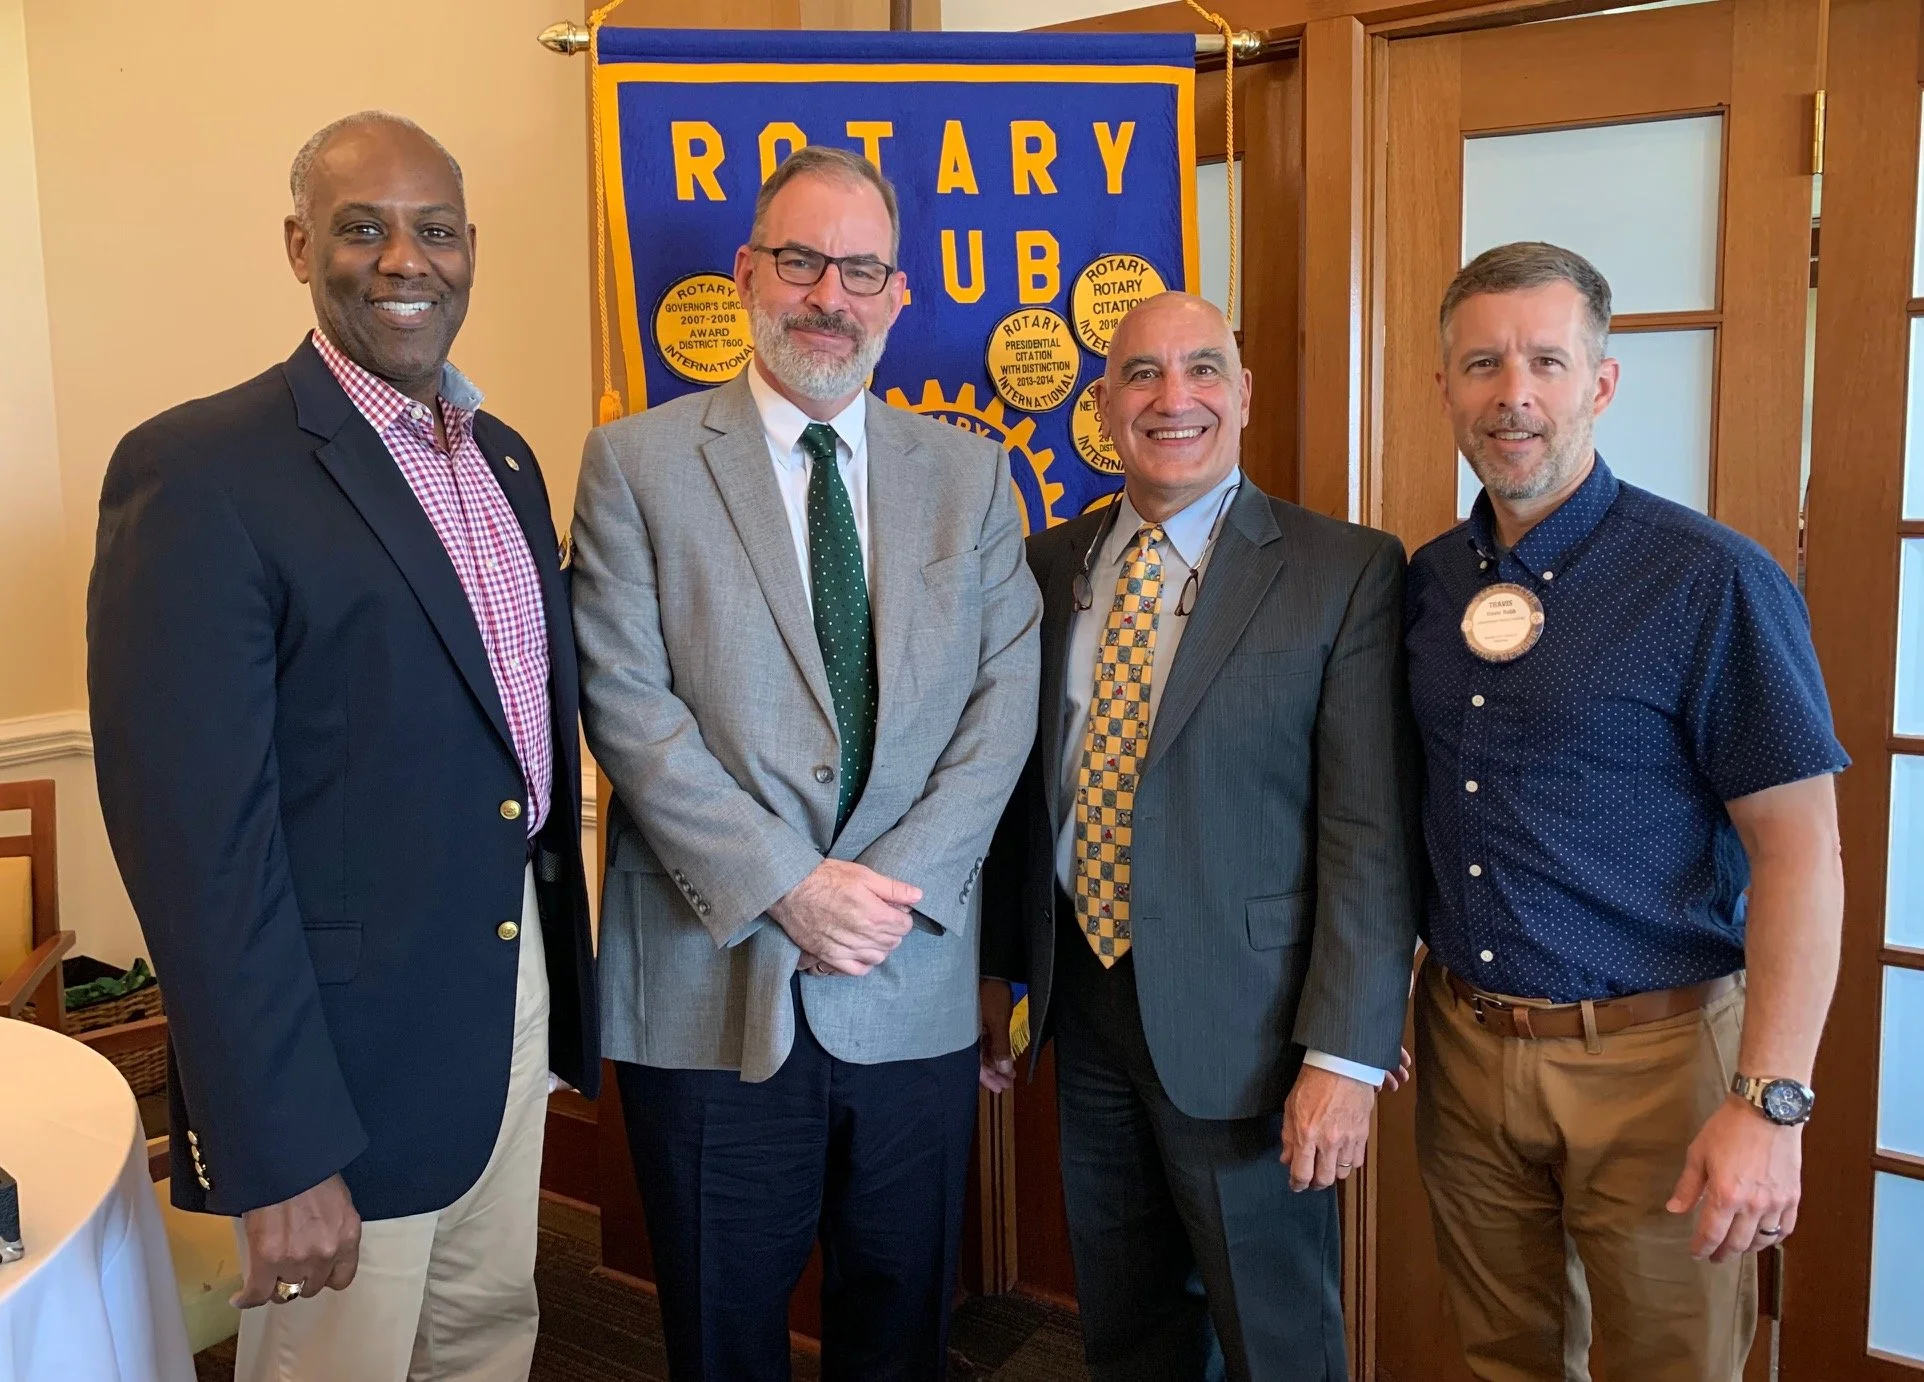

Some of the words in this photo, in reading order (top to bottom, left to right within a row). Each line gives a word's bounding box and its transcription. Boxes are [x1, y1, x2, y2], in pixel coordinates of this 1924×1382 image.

[671, 120, 1136, 201] ROTARY
[1085, 258, 1149, 283] ROTARY
[677, 283, 736, 300] ROTARY
[1093, 279, 1143, 296] ROTARY
[665, 302, 719, 312] GOVERNOR'S
[1092, 297, 1147, 315] CITATIO
[681, 314, 736, 325] 2007-2008
[1003, 315, 1060, 337] ROTARY
[689, 328, 730, 338] AWARD
[679, 339, 719, 350] DISTRICT
[722, 338, 743, 348] 7600
[1005, 338, 1061, 350] PRESIDENTIAL
[665, 344, 755, 372] INTERNATIONAL
[1015, 350, 1052, 362] CITATION
[1000, 364, 1020, 375] WITH
[1022, 361, 1070, 374] DISTINCTION
[1017, 375, 1054, 387] 2013-2014
[998, 373, 1074, 408] INTERNATIONAL
[1488, 600, 1513, 608] TRAVIS
